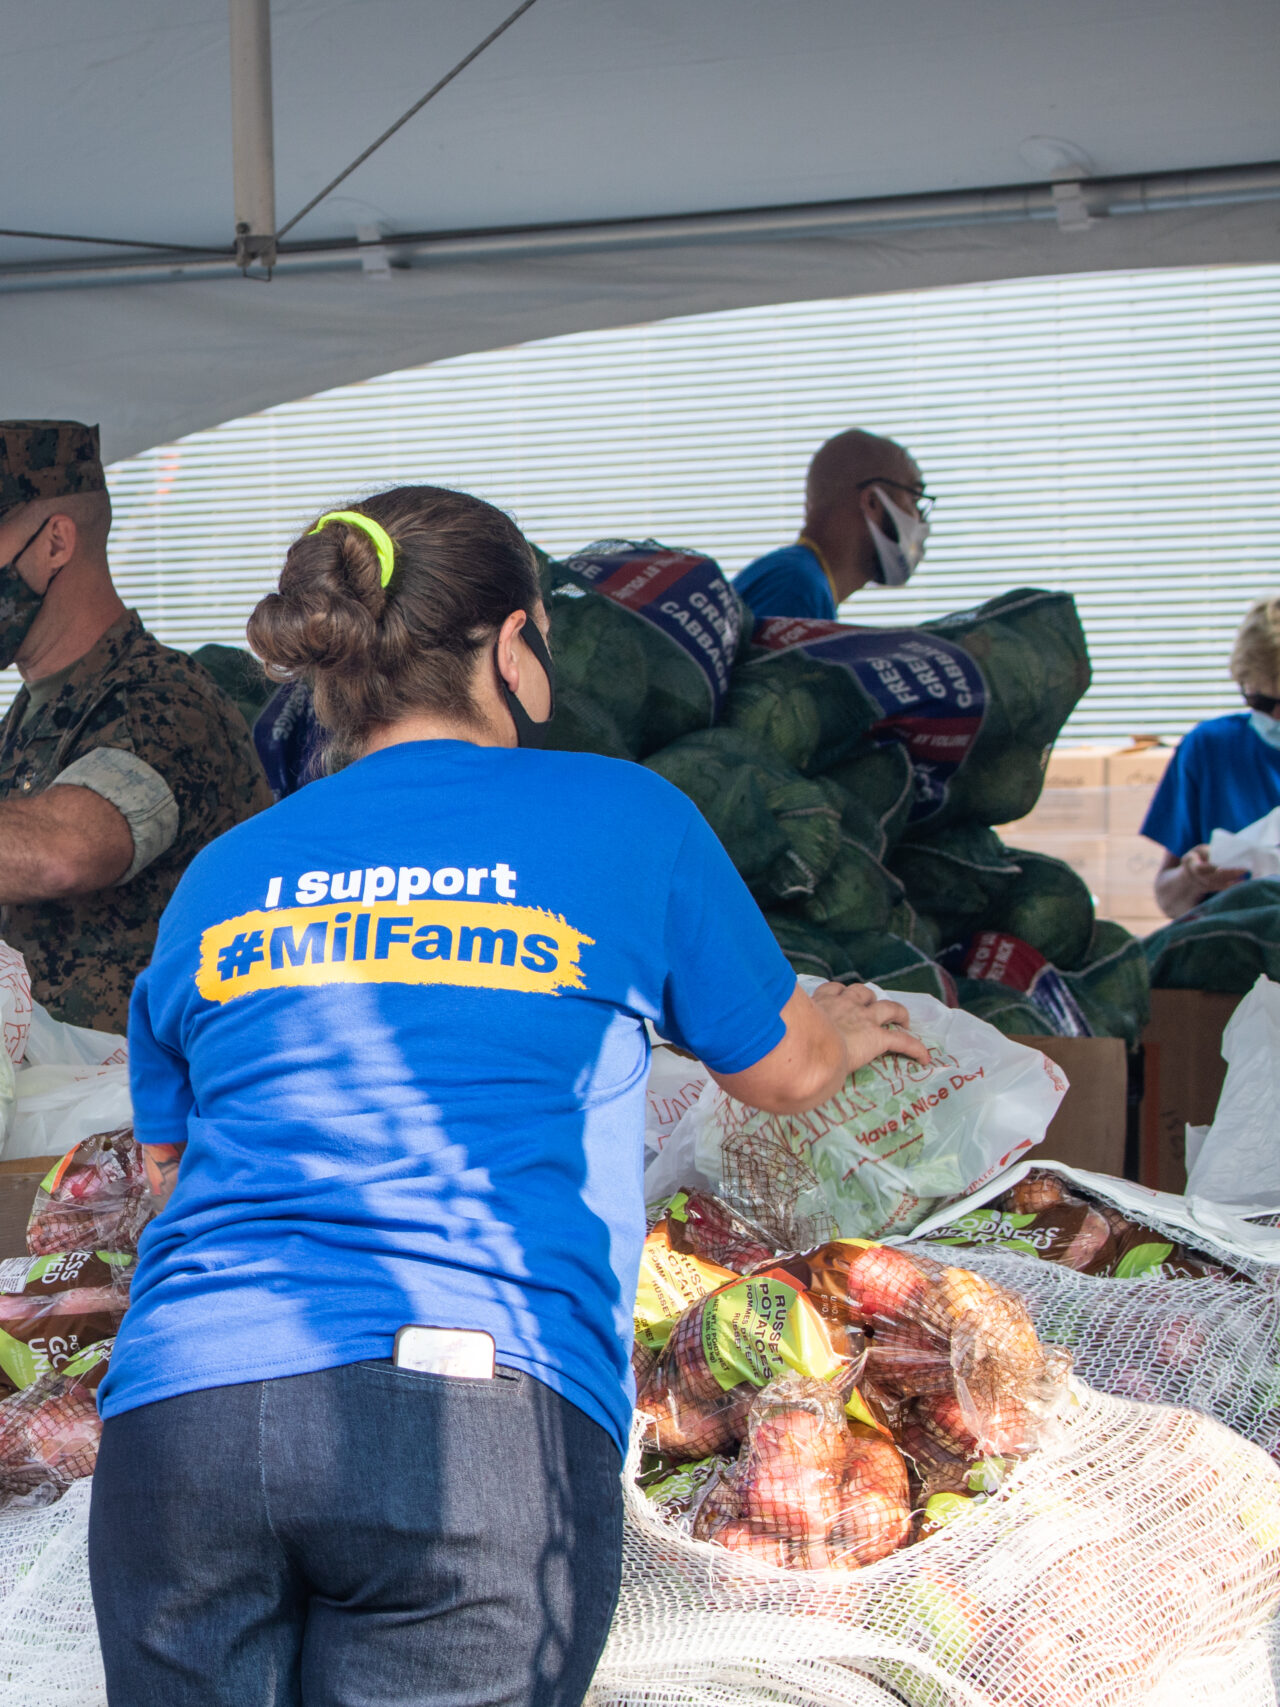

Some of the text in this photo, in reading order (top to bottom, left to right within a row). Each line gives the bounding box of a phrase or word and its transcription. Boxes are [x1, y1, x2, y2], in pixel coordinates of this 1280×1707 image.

[265, 863, 517, 908] I support
[218, 912, 559, 982] #MilFams
[855, 1118, 899, 1147] Have
[901, 1108, 915, 1126] A
[741, 1284, 754, 1325] POMMES
[754, 1283, 774, 1380] POTATOES
[768, 1294, 787, 1365] RUSSET
